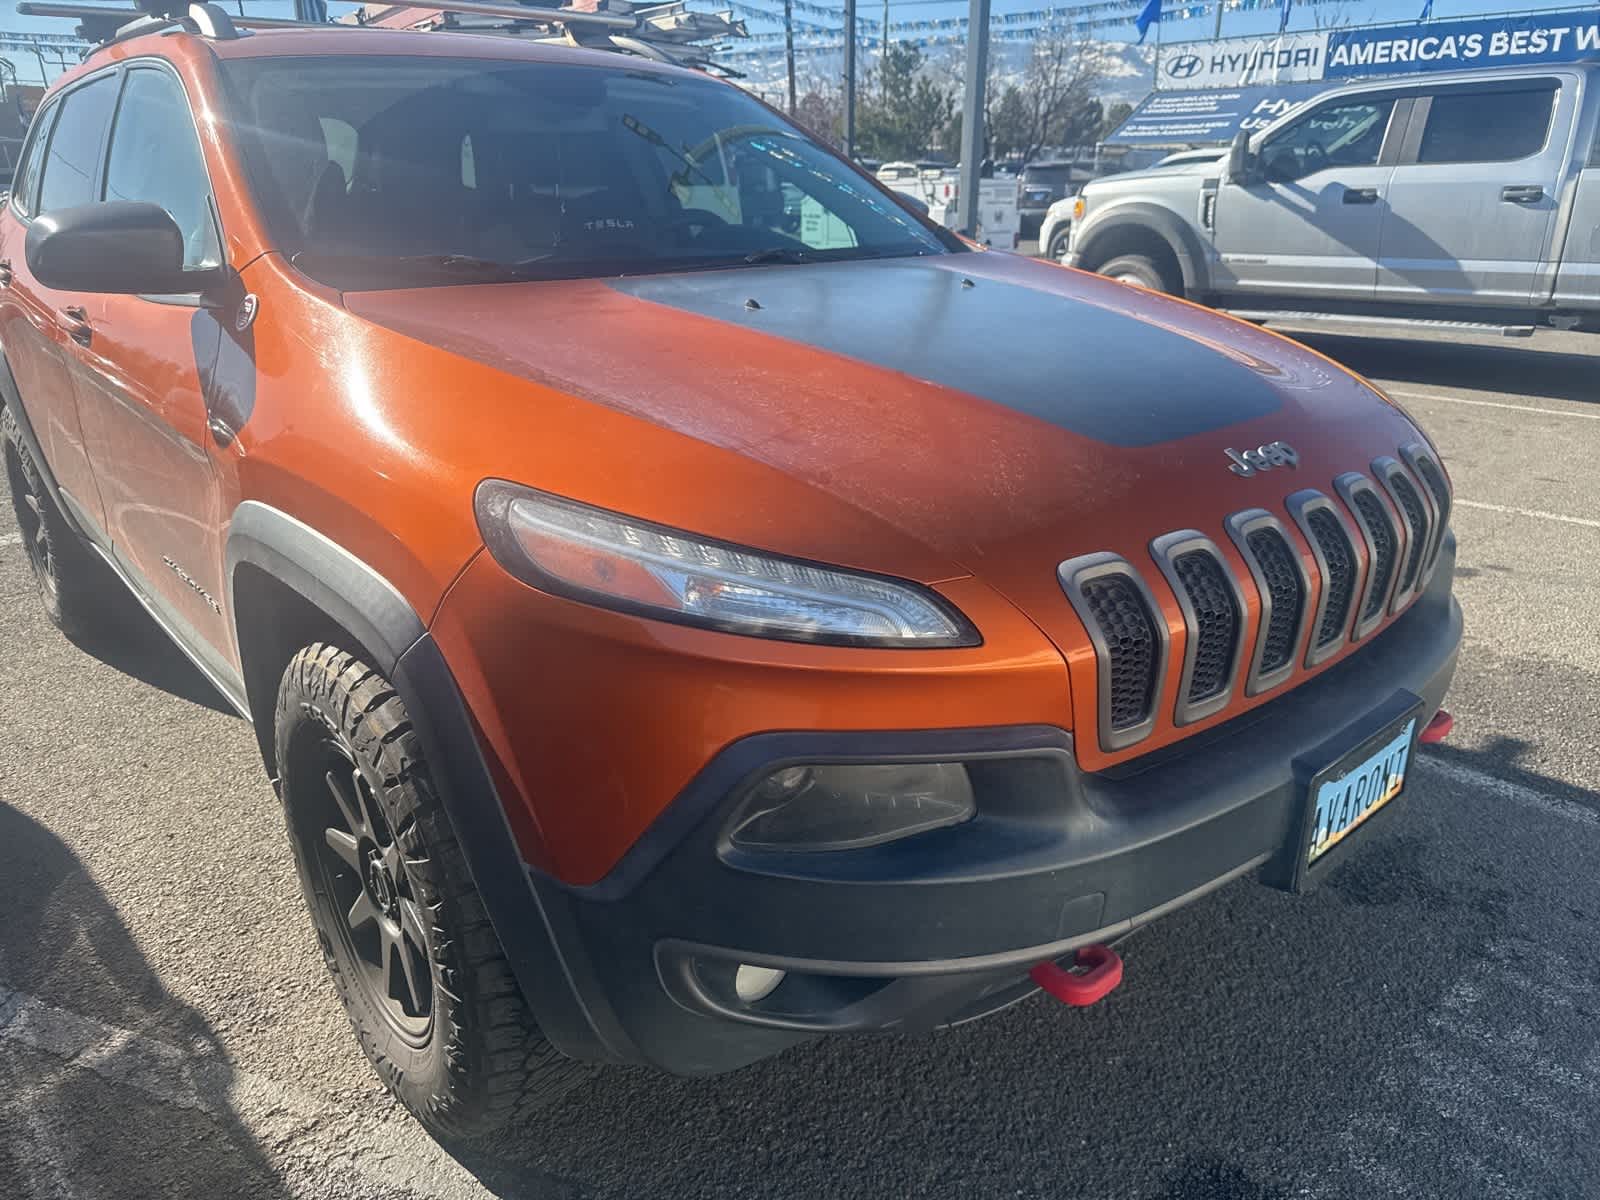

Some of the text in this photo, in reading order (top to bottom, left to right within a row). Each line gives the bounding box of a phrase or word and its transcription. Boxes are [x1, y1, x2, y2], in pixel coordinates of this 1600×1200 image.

[1210, 47, 1319, 73] HYUNDAI
[1329, 33, 1484, 67] AMERICA'S
[1488, 27, 1570, 56] BEST
[1223, 441, 1299, 477] Jeep
